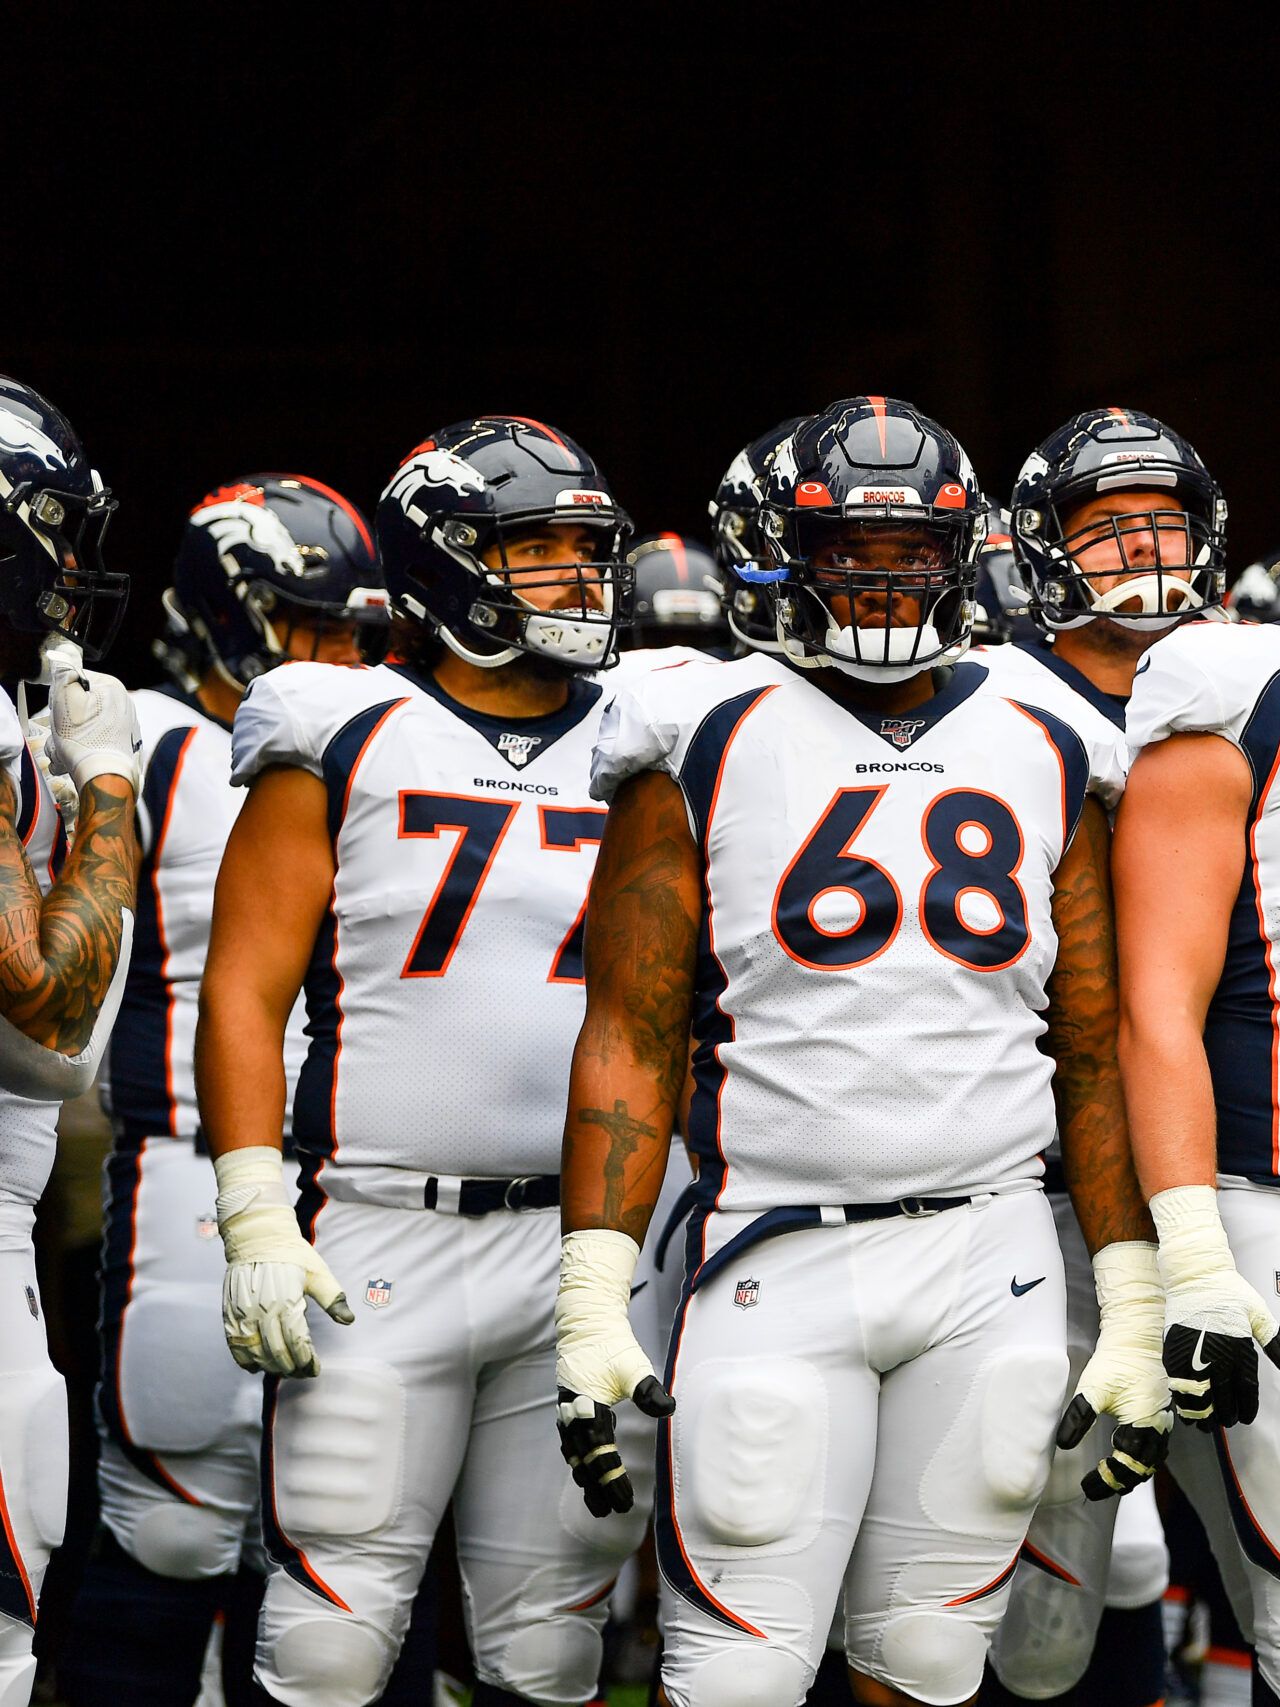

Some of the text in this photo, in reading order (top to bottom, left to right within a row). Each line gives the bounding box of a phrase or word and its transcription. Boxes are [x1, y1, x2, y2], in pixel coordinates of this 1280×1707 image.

[863, 491, 906, 503] BRONCOS
[855, 762, 945, 774] BRONCOS
[473, 778, 559, 796] BRONCOS
[771, 783, 1032, 973] 68
[737, 1290, 755, 1303] NFL
